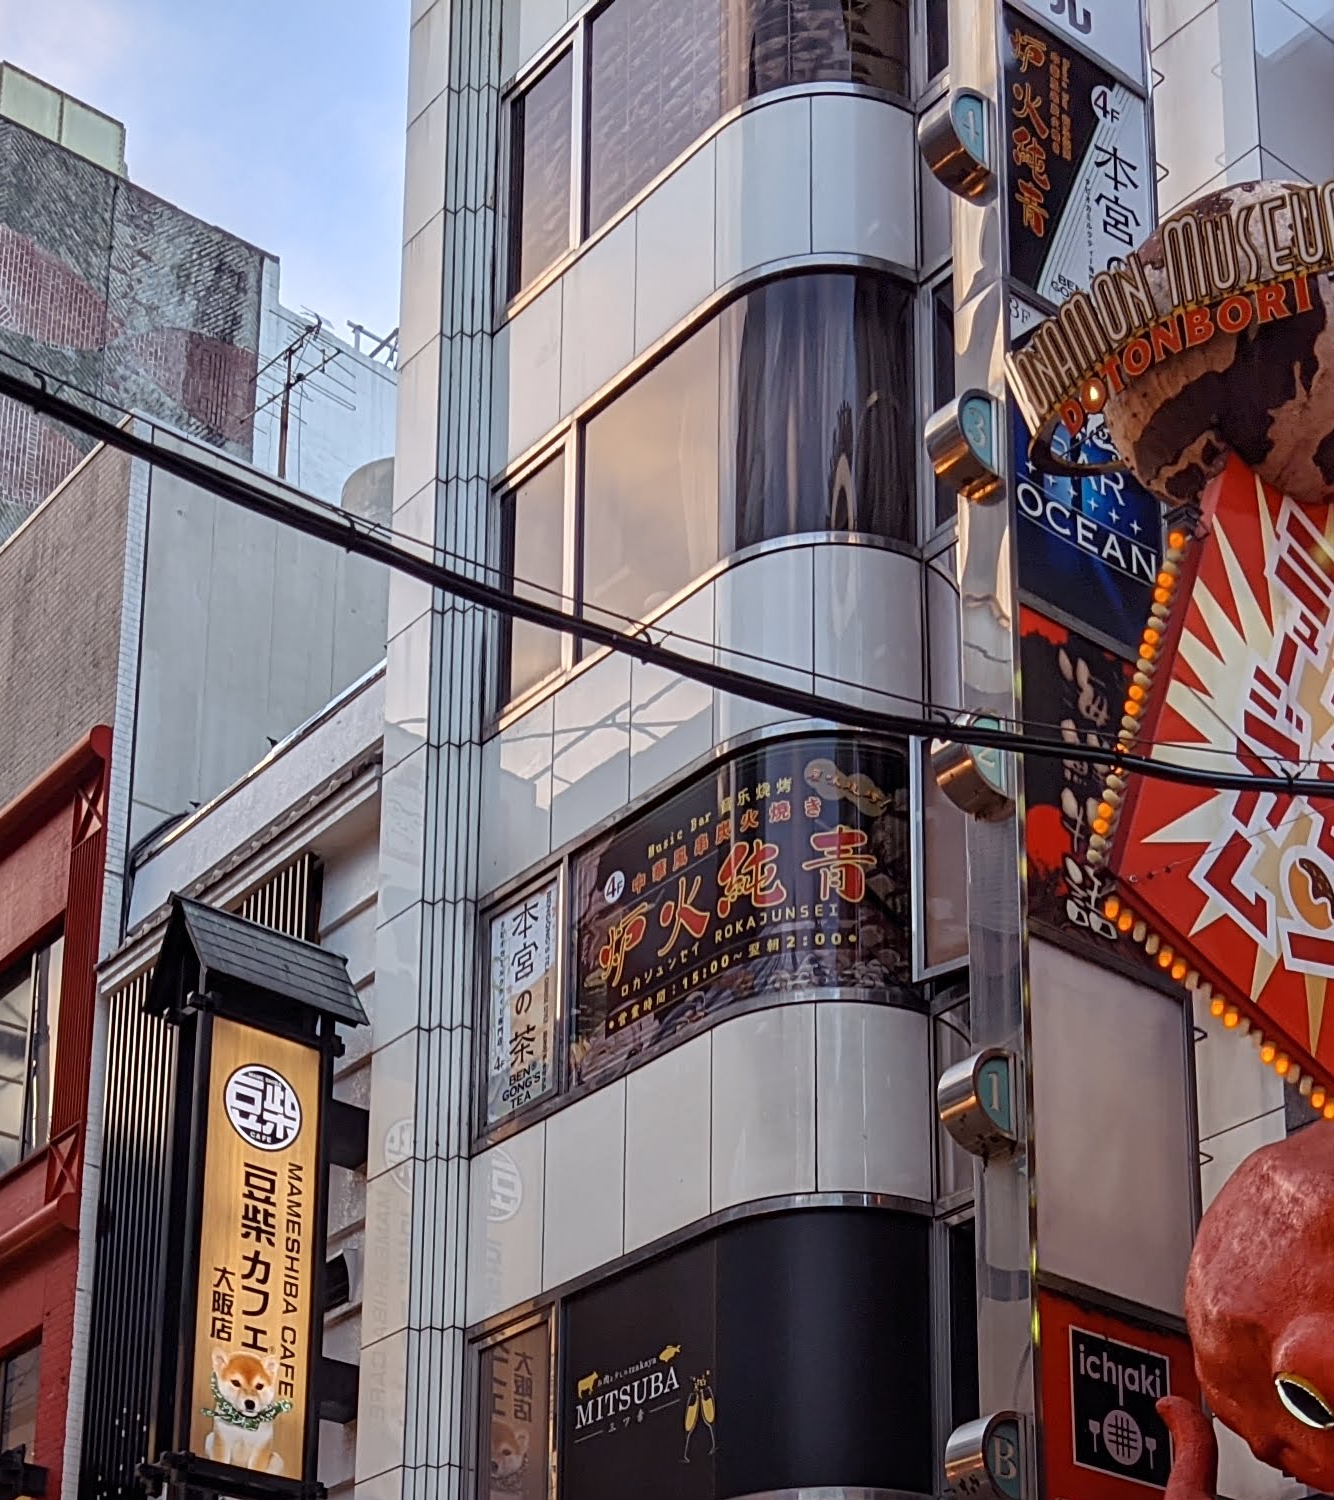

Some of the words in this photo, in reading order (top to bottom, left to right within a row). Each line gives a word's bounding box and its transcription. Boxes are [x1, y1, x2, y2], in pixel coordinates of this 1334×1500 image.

[1094, 89, 1120, 123] 4F
[1061, 275, 1313, 437] DOTONBORI
[1017, 483, 1156, 583] OCEAN
[690, 811, 712, 831] Bar
[605, 876, 624, 898] 4F
[715, 903, 838, 944] ROKAJUNSEI
[509, 901, 540, 1069] 本宮の茶
[502, 1073, 540, 1101] GONG'S
[509, 1067, 531, 1086] BEN
[509, 1092, 531, 1110] TEA
[239, 1162, 279, 1353] 豆柴カフェ
[283, 1162, 302, 1315] MAMESHIBA
[210, 1267, 234, 1344] 大阪店
[279, 1325, 296, 1399] CAFE
[576, 1366, 679, 1429] MITSUBA
